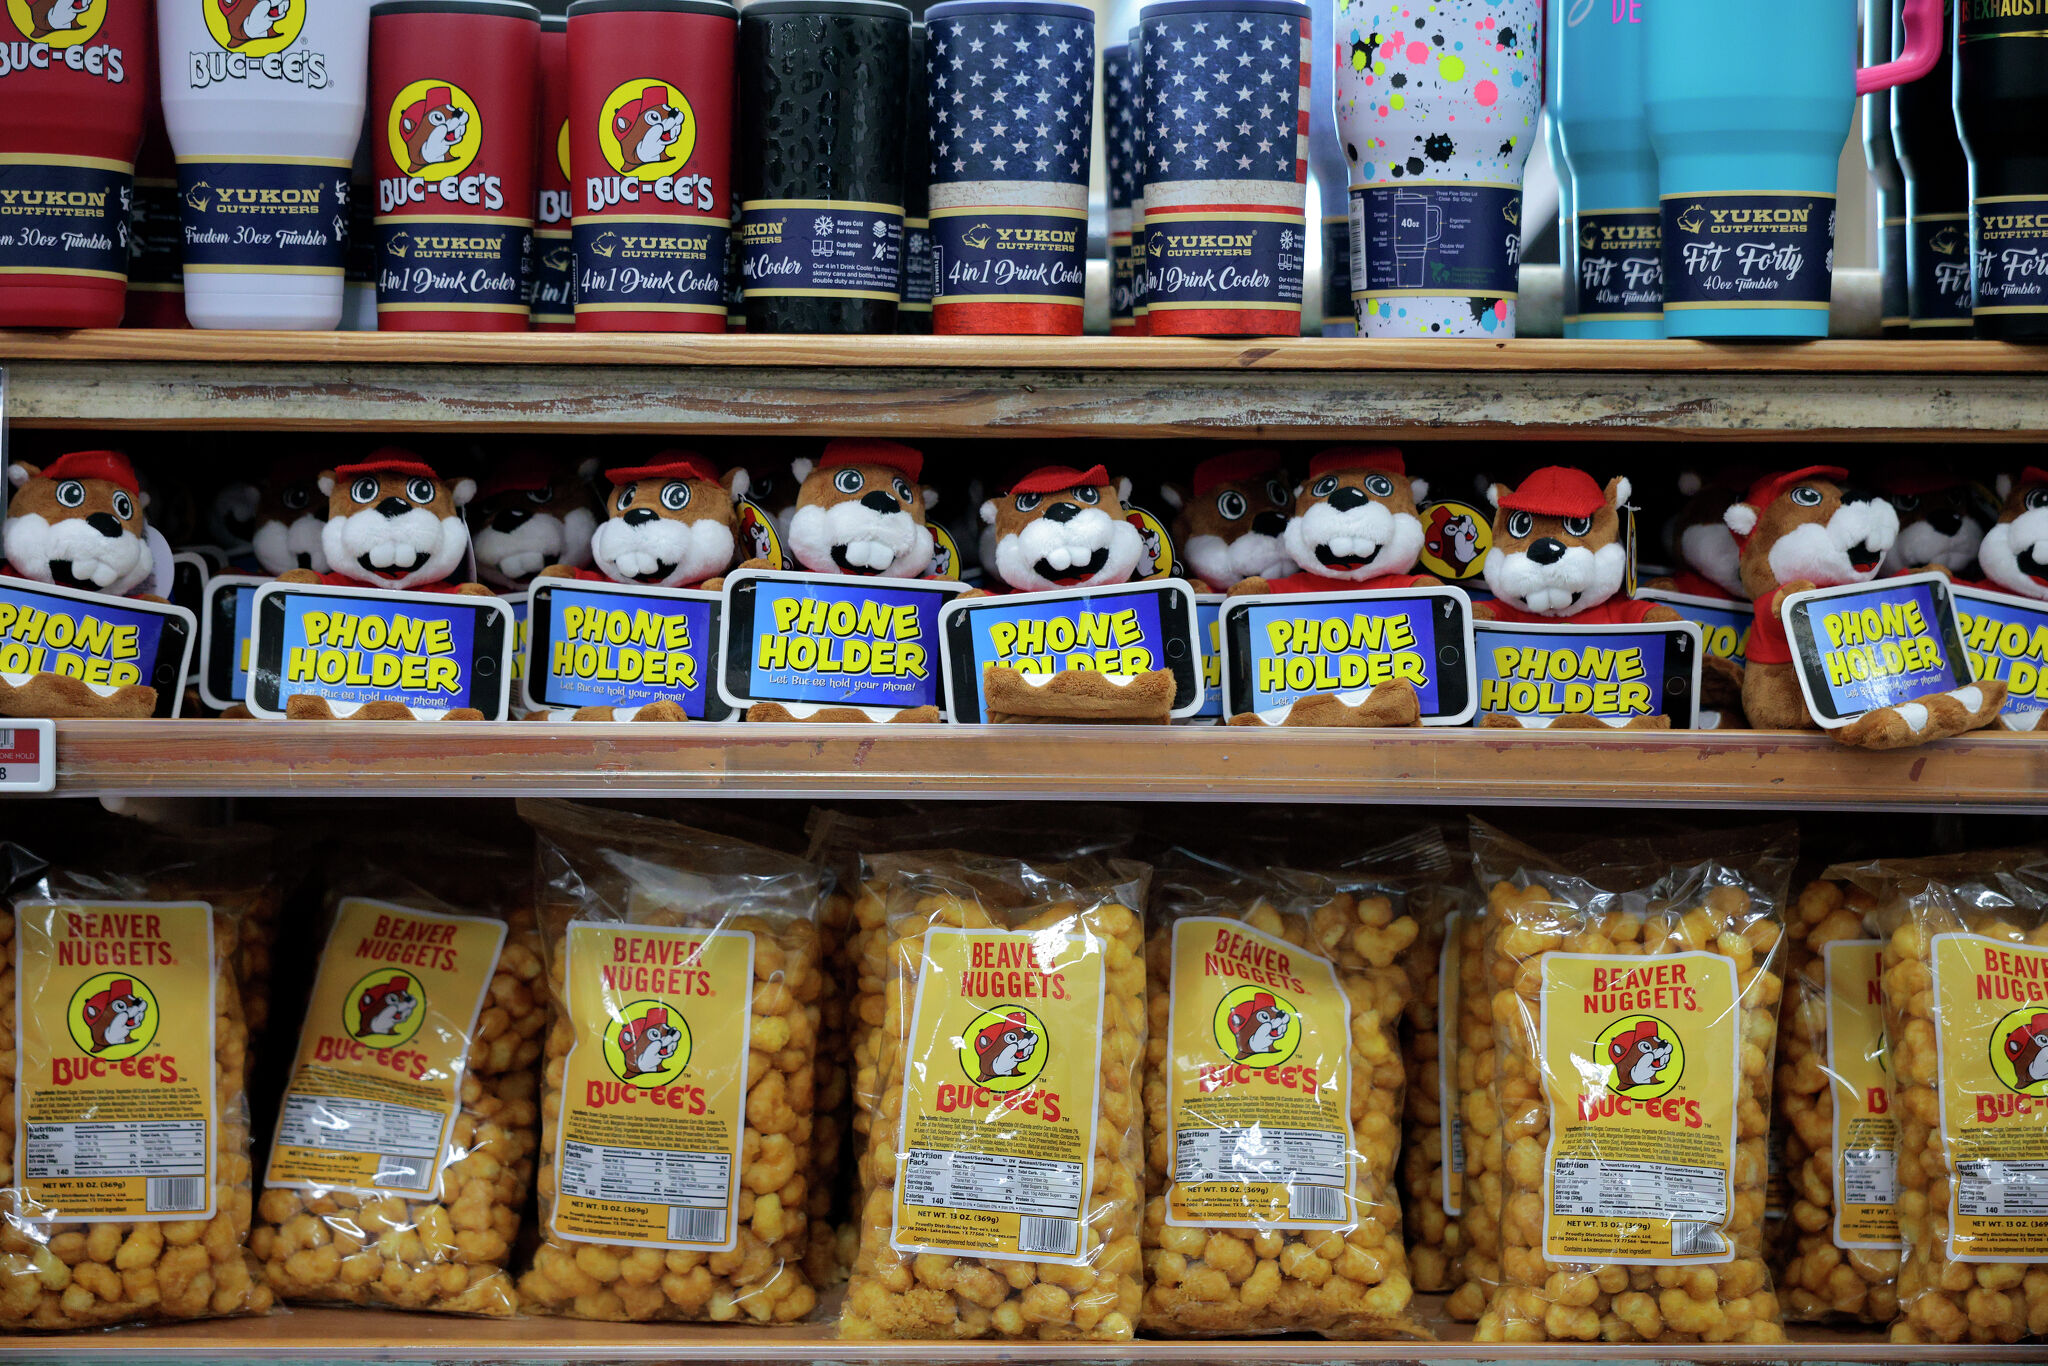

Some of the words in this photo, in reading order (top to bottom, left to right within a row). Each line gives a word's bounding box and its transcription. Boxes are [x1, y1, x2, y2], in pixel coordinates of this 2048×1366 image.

[189, 50, 329, 89] BUC-EE'S
[216, 188, 321, 203] YUKON
[379, 173, 504, 213] BUC-EE'S
[586, 173, 714, 213] BUC-EE'S
[1, 207, 105, 218] OUTFITTERS
[216, 204, 320, 214] OUTFITTERS
[1710, 208, 1809, 222] YUKON
[1983, 214, 2048, 229] YUKO
[997, 228, 1076, 243] YUKON
[1401, 218, 1420, 228] 40oz
[1711, 225, 1808, 233] OUTFITTERS
[17, 227, 57, 248] 30oz
[61, 231, 112, 251] Tumbler
[185, 225, 230, 245] Freedom
[236, 226, 272, 246] 30oz
[276, 229, 328, 249] Tumbler
[414, 237, 502, 250] YUKON
[622, 237, 708, 250] YUKON
[997, 243, 1075, 253] OUTFITTERS
[1167, 236, 1253, 247] YUKON
[414, 250, 501, 260] OUTFITTERS
[622, 250, 707, 260] OUTFITTERS
[1167, 249, 1252, 257] OUTFITTERS
[1682, 241, 1731, 275] Fit
[1736, 242, 1804, 280] Forty
[758, 254, 802, 279] Cooler
[949, 260, 961, 285] 4
[962, 264, 978, 281] in
[979, 260, 991, 284] 1
[994, 260, 1049, 287] Drink
[1050, 260, 1083, 285] Cooler
[1167, 267, 1217, 292] Drink
[1219, 266, 1271, 290] Cooler
[1582, 256, 1619, 290] Fit
[1622, 257, 1663, 290] For
[379, 270, 388, 293] 4
[388, 271, 400, 291] in
[401, 268, 409, 292] 1
[413, 268, 468, 295] Drink
[470, 268, 516, 294] Cooler
[581, 269, 590, 293] 4
[590, 270, 607, 290] in
[607, 268, 618, 291] 1
[622, 267, 676, 295] Drink
[677, 268, 720, 293] Cooler
[1703, 276, 1733, 290] 40oz
[1735, 276, 1779, 293] Tumbler
[2001, 282, 2041, 298] Tumbler
[302, 610, 456, 655] PHONE
[563, 605, 692, 651] PHONE
[772, 597, 922, 642] PHONE
[1822, 599, 1928, 649] PHONE
[988, 608, 1145, 658] PHONE
[1265, 613, 1417, 656] PHONE
[1957, 612, 2048, 664] PHON
[552, 641, 700, 691] HOLDER
[758, 633, 931, 681] HOLDER
[1492, 646, 1646, 682] PHONE
[1824, 636, 1946, 687] HOLDER
[287, 646, 464, 696] HOLDER
[769, 674, 788, 684] Let
[829, 678, 850, 689] hold
[854, 680, 879, 692] your
[882, 682, 916, 693] phone!
[1258, 651, 1430, 694] HOLDER
[560, 681, 574, 690] Let
[607, 685, 625, 696] hold
[628, 688, 651, 700] your
[654, 691, 686, 702] phone!
[1480, 678, 1654, 715] HOLDER
[68, 913, 161, 939] BEAVER
[373, 914, 458, 946] BEAVER
[58, 941, 172, 966] NUGGETS
[355, 938, 457, 972] NUGGETS
[613, 937, 703, 968] BEAVER
[972, 942, 1056, 969] BEAVE
[1215, 929, 1290, 975] BEAVER
[603, 965, 711, 997] NUGGETS
[960, 972, 1065, 1000] NUGGETS
[1205, 952, 1305, 994] NUGGETS
[1593, 963, 1686, 993] BEAVER
[1584, 986, 1696, 1014] NUGGETS
[52, 1054, 178, 1086] BUC-EE'S
[314, 1036, 428, 1081] BUC-EE'S
[586, 1079, 707, 1116] BUC-EE'S
[1578, 1094, 1703, 1129] BUC-EE'S
[1178, 1131, 1210, 1139] Nutrition
[910, 1151, 943, 1159] Nutrition
[56, 1168, 69, 1176] 140
[100, 1181, 126, 1190] (369g)
[1244, 1187, 1269, 1195] (369g)
[571, 1201, 585, 1209] NET
[624, 1206, 649, 1215] (369g)
[932, 1197, 944, 1205] 140
[1581, 1206, 1594, 1214] 140
[1985, 1206, 1998, 1214] 140
[933, 1211, 948, 1219] WT.
[960, 1213, 972, 1221] OZ.
[974, 1215, 1000, 1225] (369g)
[1973, 1220, 1986, 1228] NET
